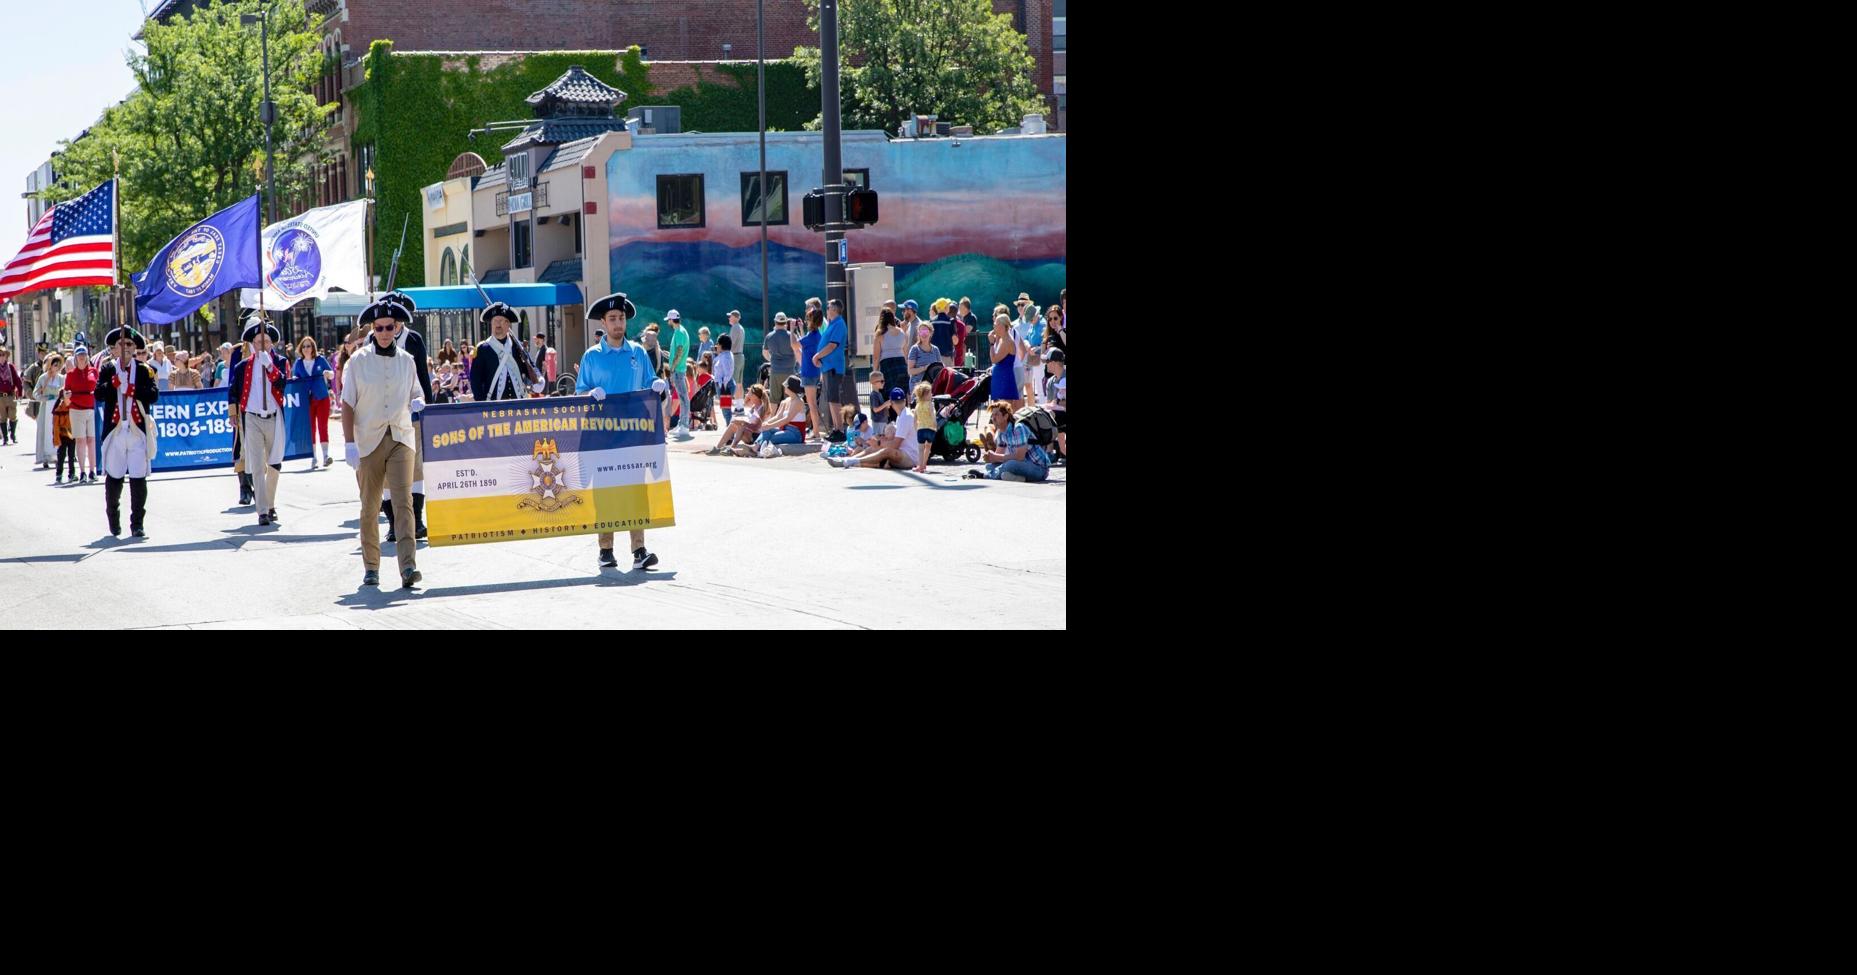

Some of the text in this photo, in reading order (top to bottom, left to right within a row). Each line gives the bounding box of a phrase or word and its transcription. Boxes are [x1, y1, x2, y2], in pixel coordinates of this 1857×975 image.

[150, 404, 190, 419] ERN
[195, 401, 228, 417] EXP
[482, 403, 604, 419] NEBRASKA SOCIETY
[432, 417, 655, 448] SONS OF THE AMERICAN REVOLUTION
[165, 447, 232, 457] WWW.PATRIOTICPRODUCTION
[597, 461, 657, 473] www.nessar.org
[437, 478, 497, 490] APRIL 26TH 1890
[451, 518, 650, 540] PATRIOTISM HISTORY EDUCATION
